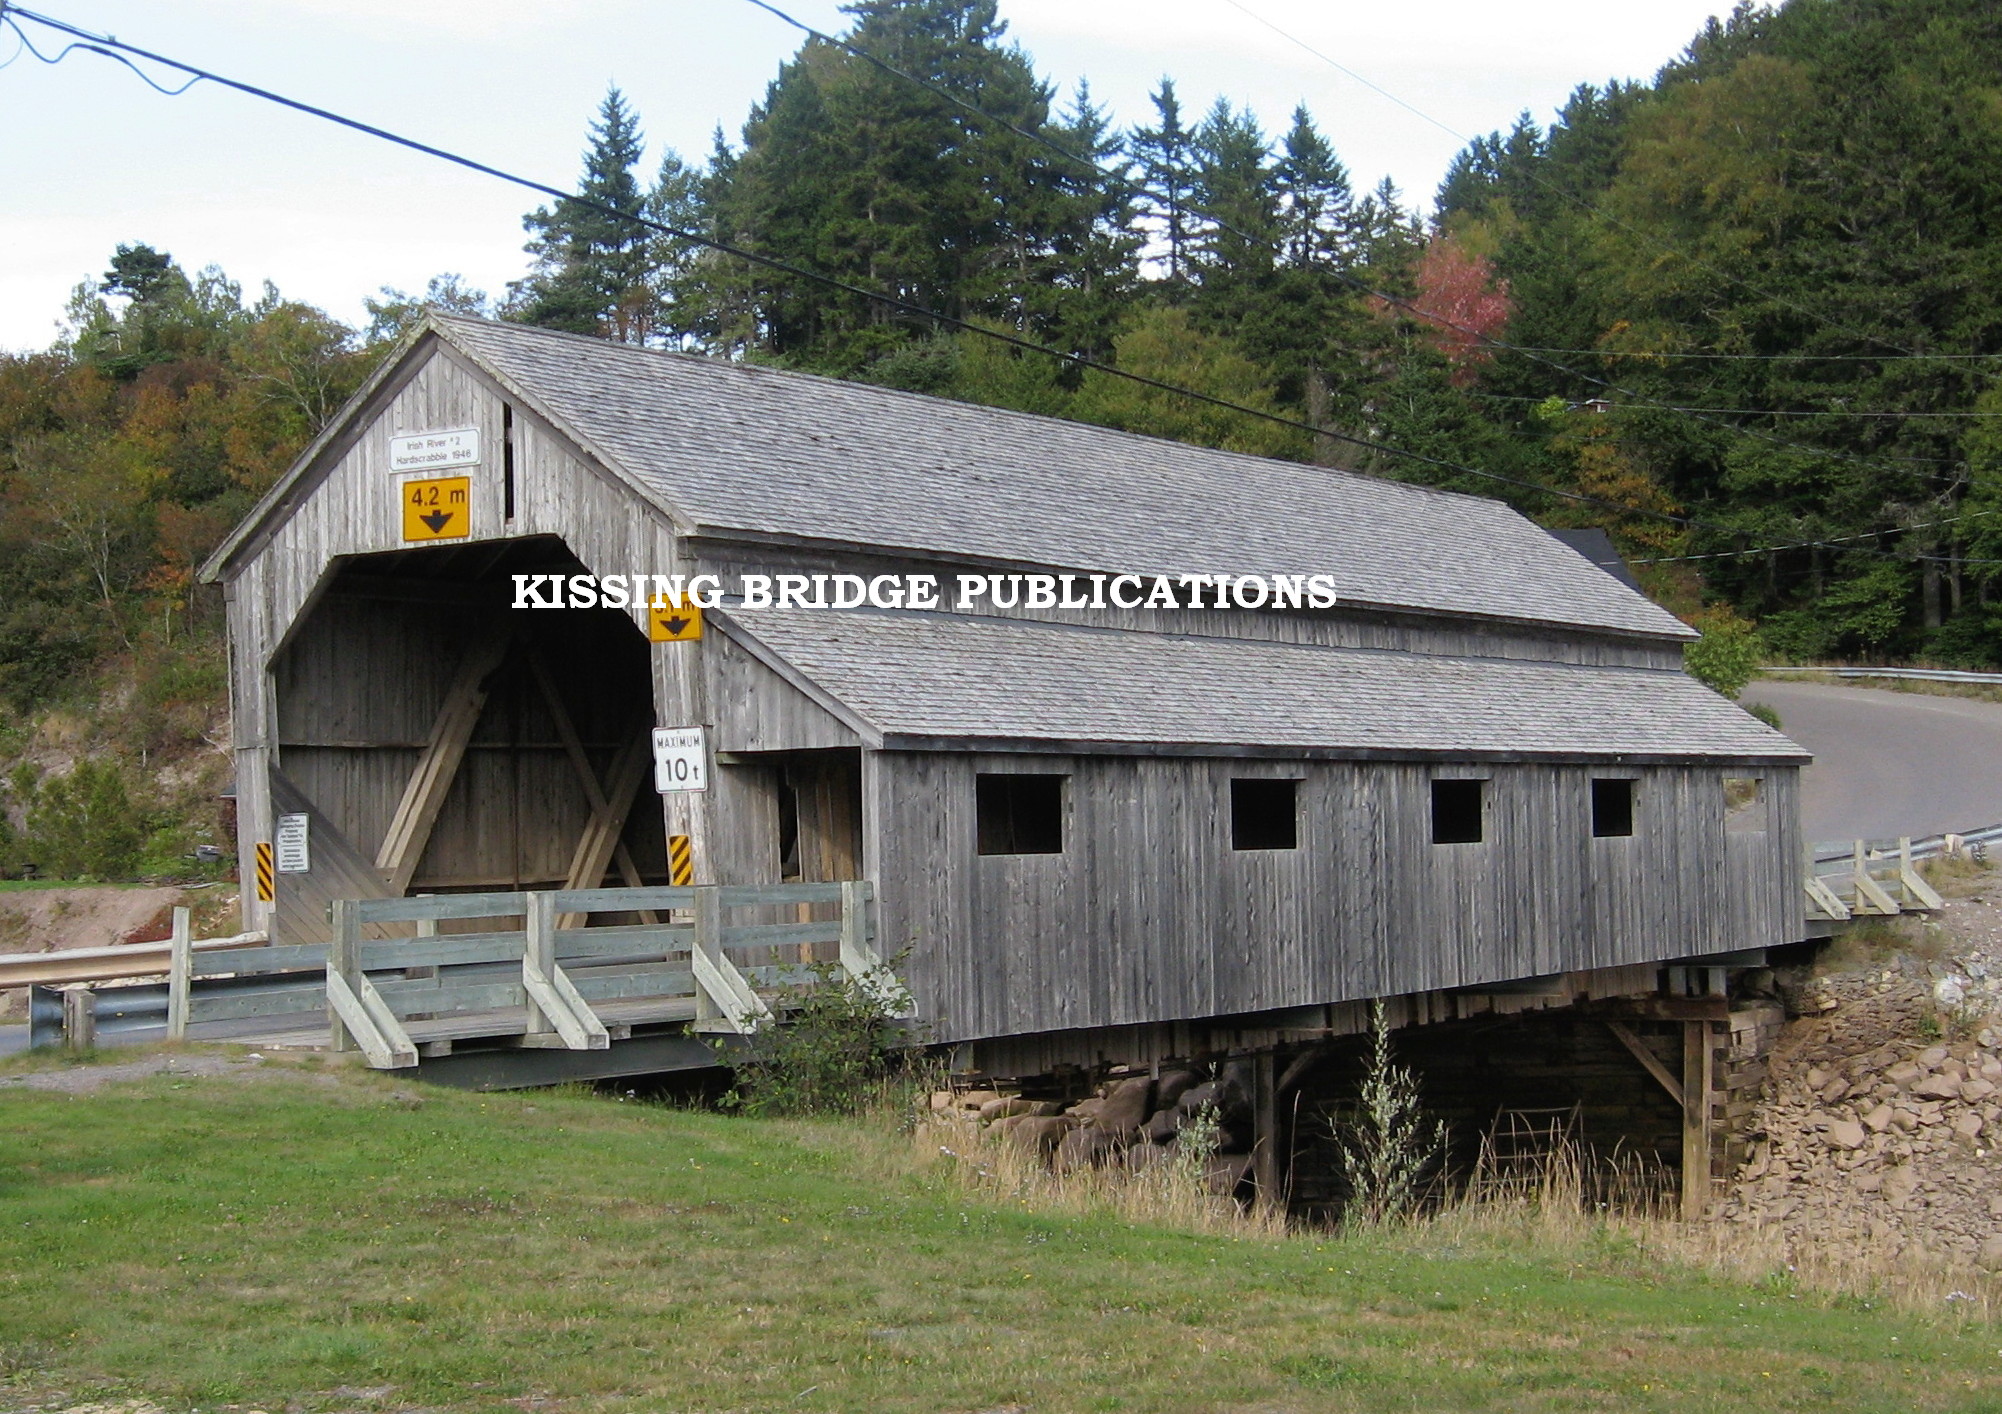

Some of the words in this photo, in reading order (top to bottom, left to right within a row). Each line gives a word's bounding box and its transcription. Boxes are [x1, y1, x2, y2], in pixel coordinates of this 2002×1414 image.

[406, 441, 424, 450] Irish
[427, 439, 447, 448] River
[411, 486, 439, 506] 4.2
[450, 488, 465, 504] m
[657, 736, 700, 748] MAXIMUM
[665, 758, 688, 782] 10
[692, 765, 699, 780] t
